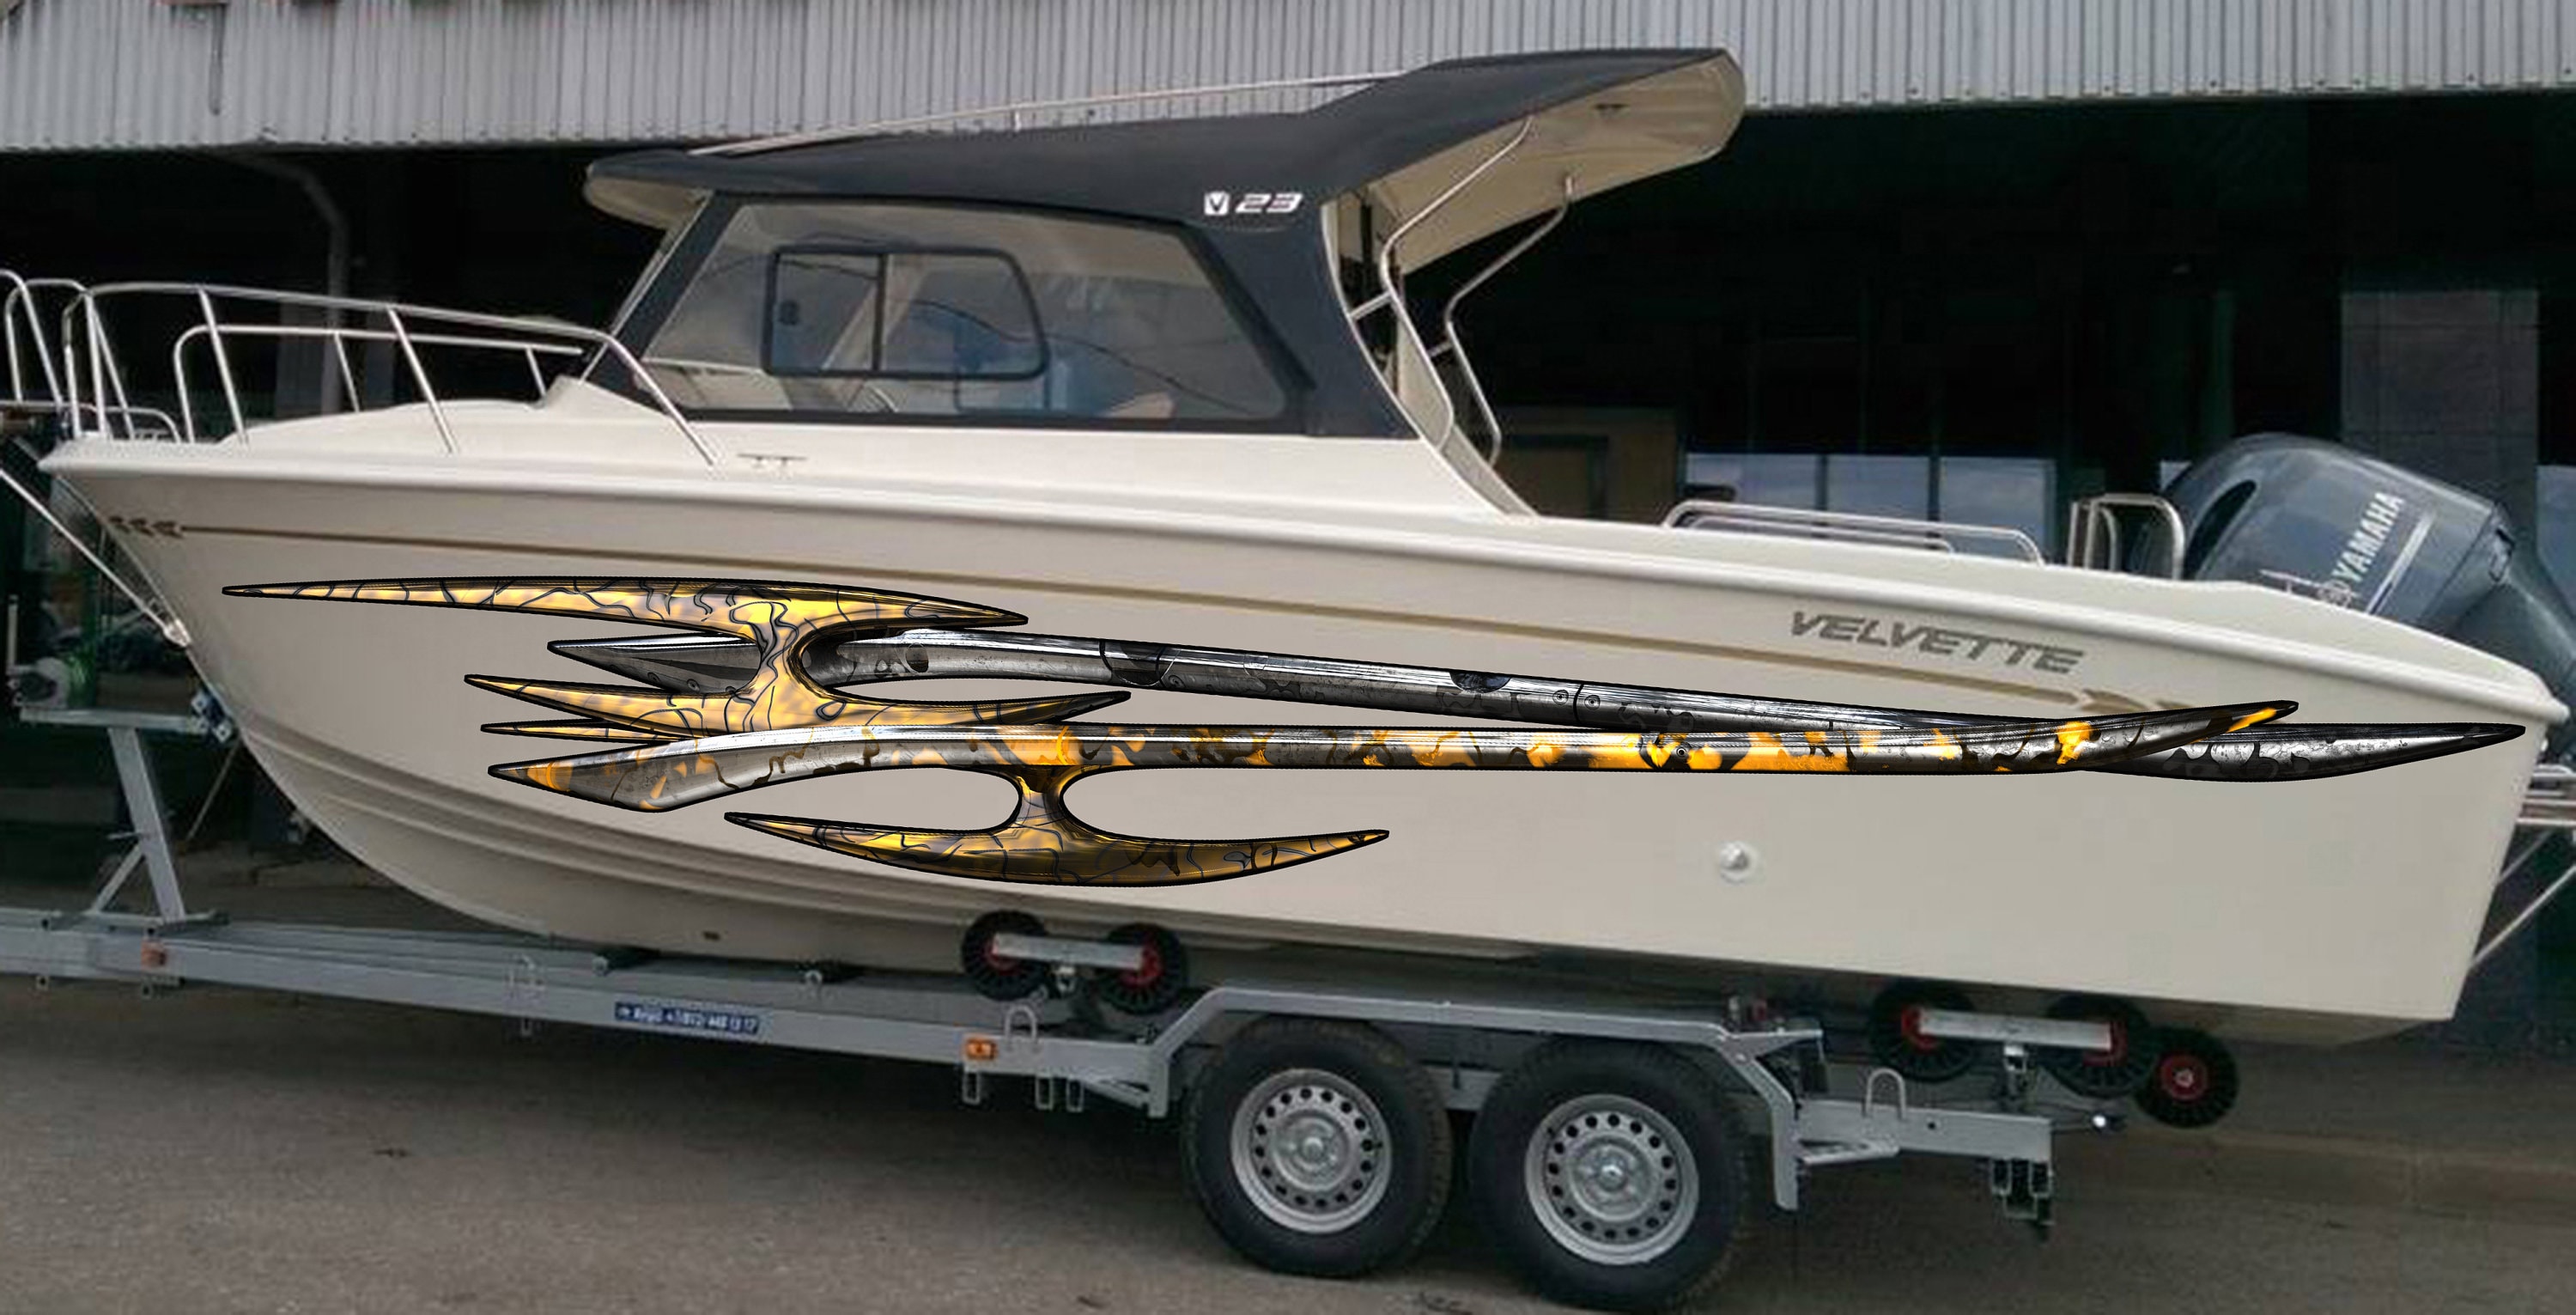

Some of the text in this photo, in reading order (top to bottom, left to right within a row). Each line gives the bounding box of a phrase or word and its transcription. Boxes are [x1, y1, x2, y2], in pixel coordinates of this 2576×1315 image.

[1236, 192, 1303, 213] 23
[2330, 492, 2405, 582] YAMAHA
[1791, 611, 2085, 674] VELVETTE
